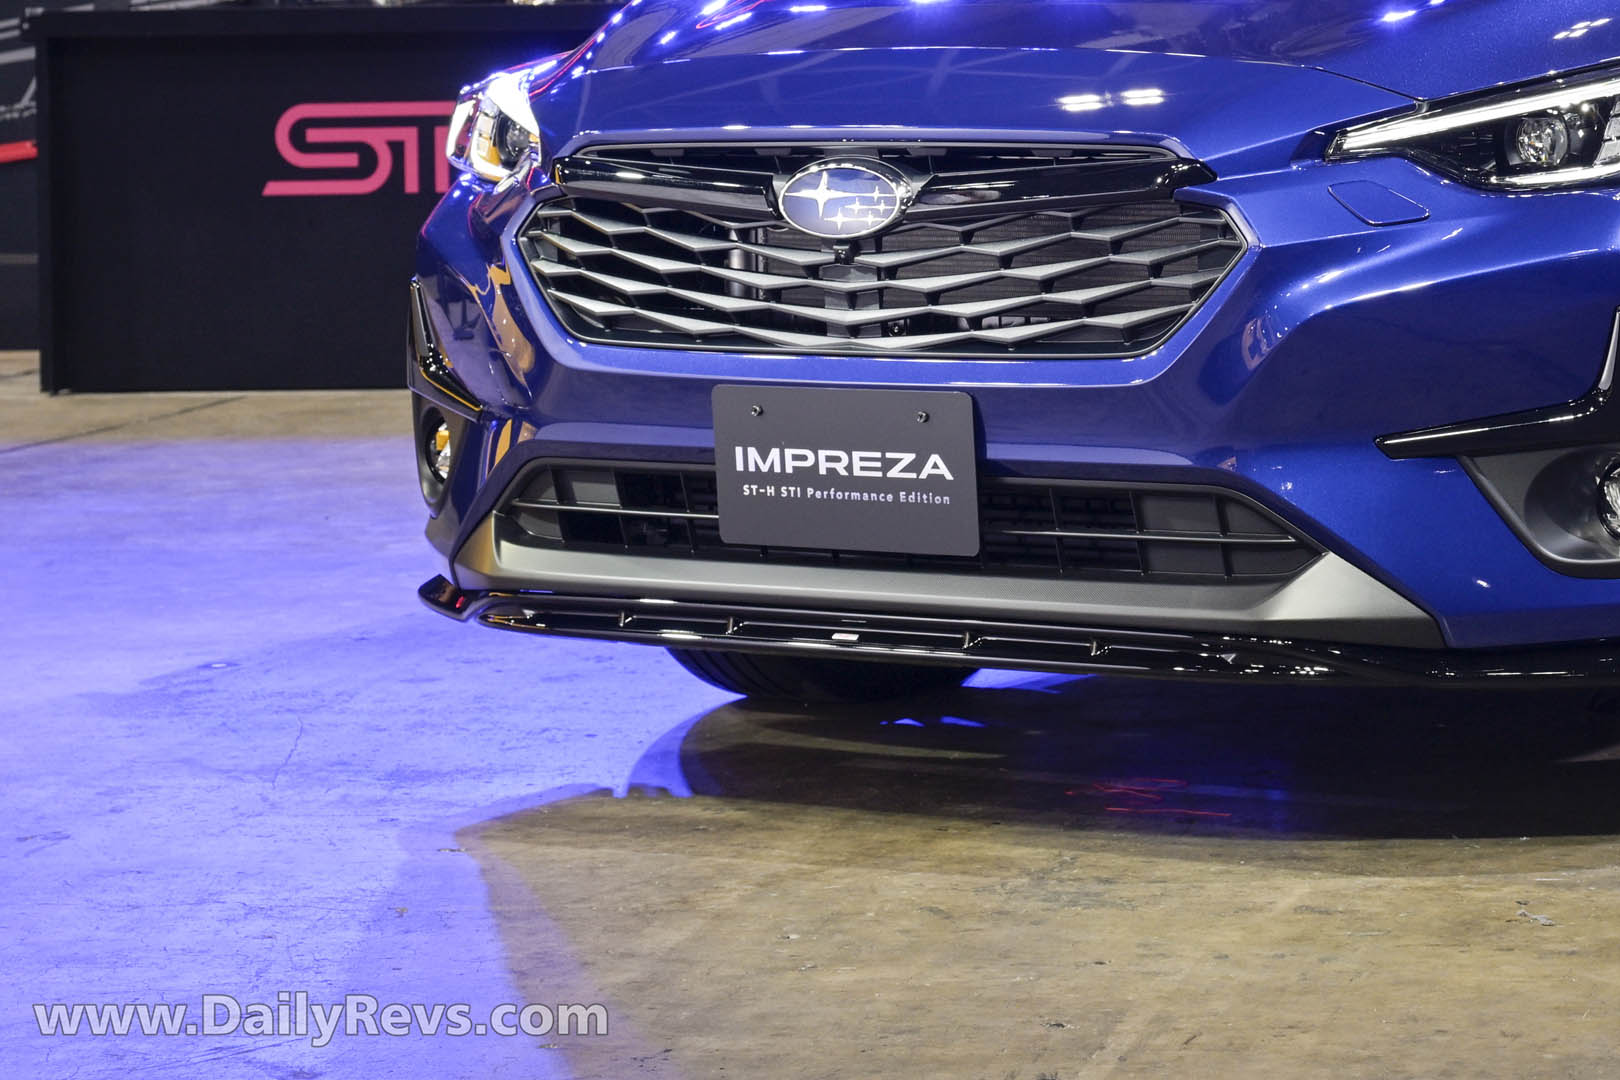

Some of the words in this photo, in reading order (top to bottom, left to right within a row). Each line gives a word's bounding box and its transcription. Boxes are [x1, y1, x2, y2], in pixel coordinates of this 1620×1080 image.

[734, 445, 954, 481] IMPREZA
[742, 484, 776, 498] ST-H
[780, 486, 801, 499] STI
[807, 487, 894, 503] Performance
[899, 491, 951, 505] Edition
